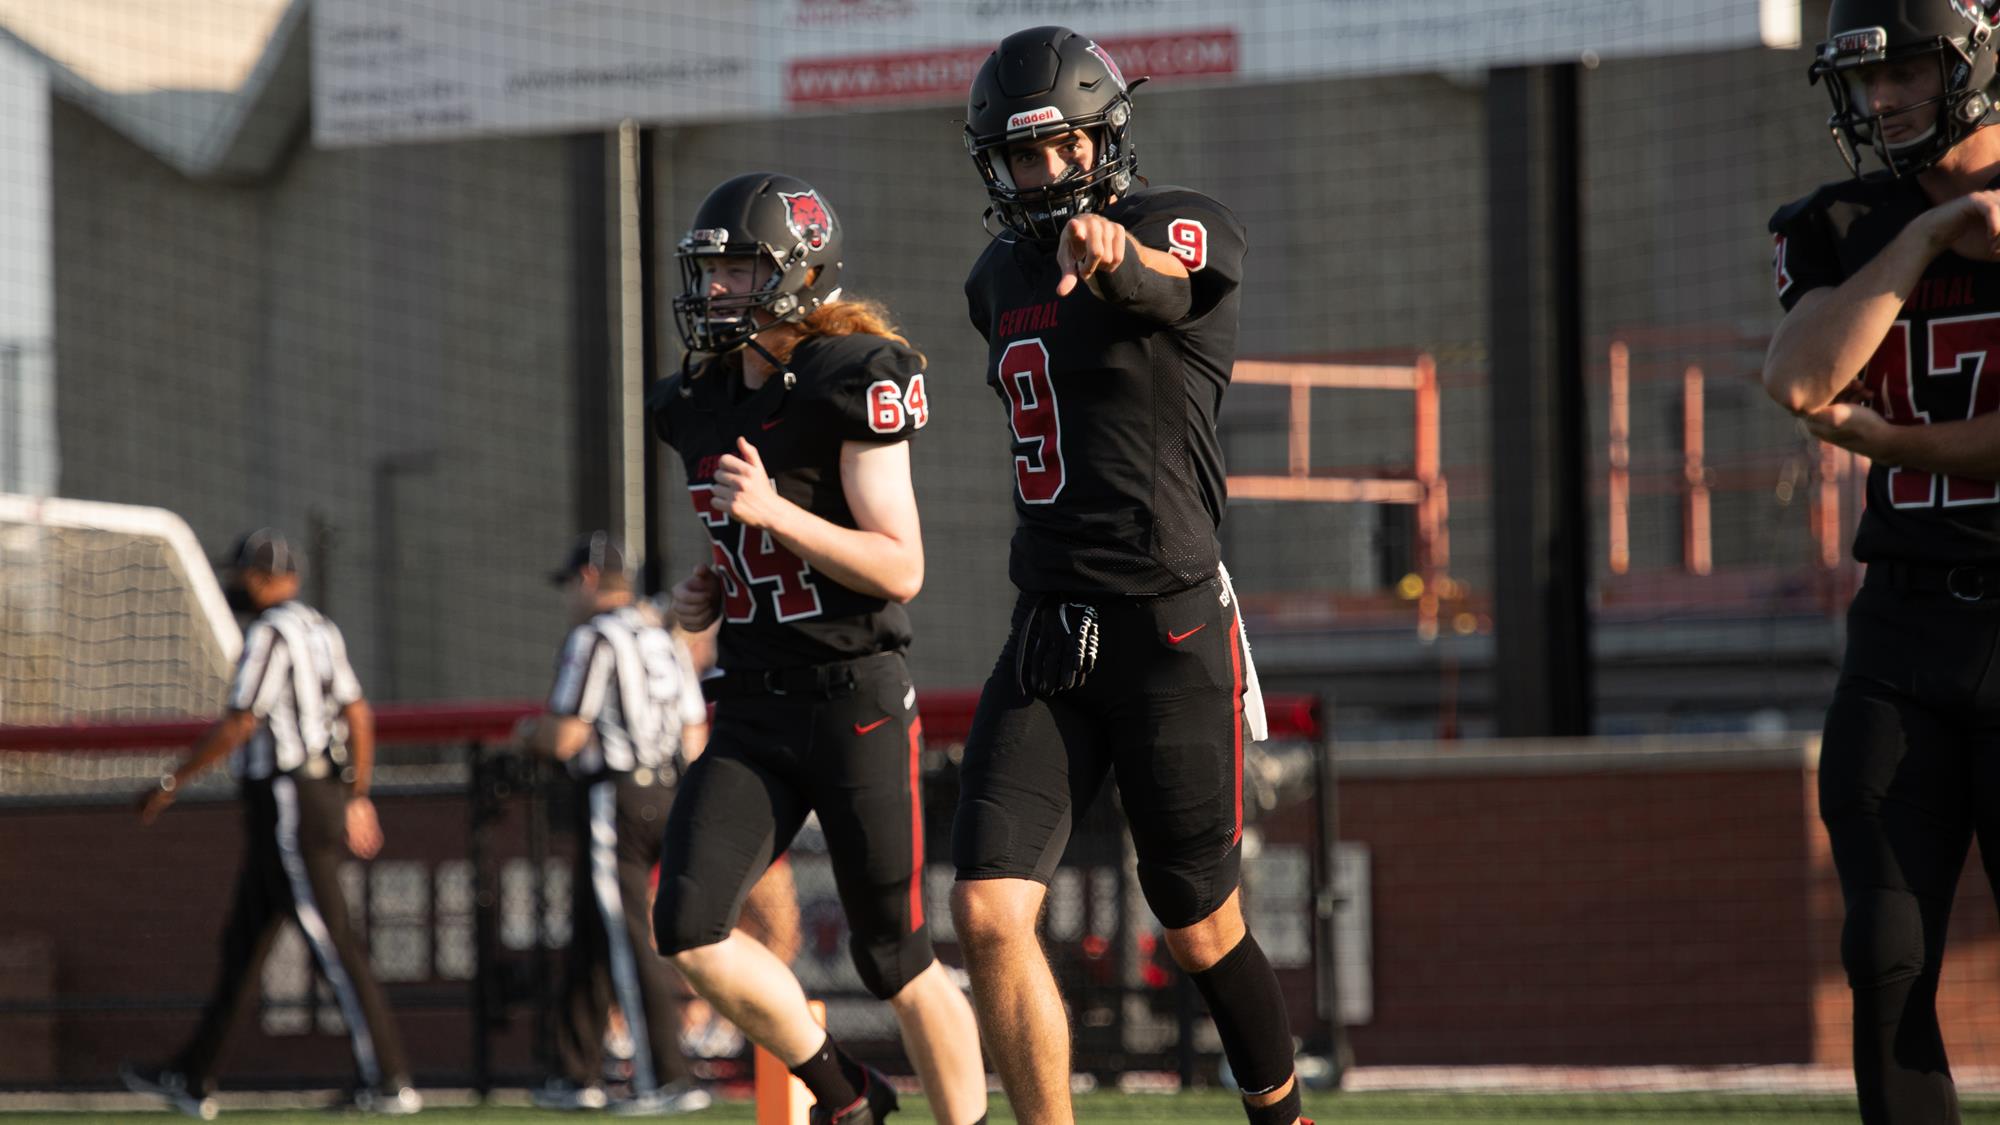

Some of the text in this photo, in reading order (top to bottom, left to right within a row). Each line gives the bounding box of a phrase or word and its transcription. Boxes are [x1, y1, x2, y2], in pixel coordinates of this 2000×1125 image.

[1011, 109, 1054, 127] Riddell
[1167, 217, 1208, 272] 9
[1000, 300, 1058, 337] CENTRAL
[867, 373, 929, 434] 64
[998, 337, 1066, 504] 9
